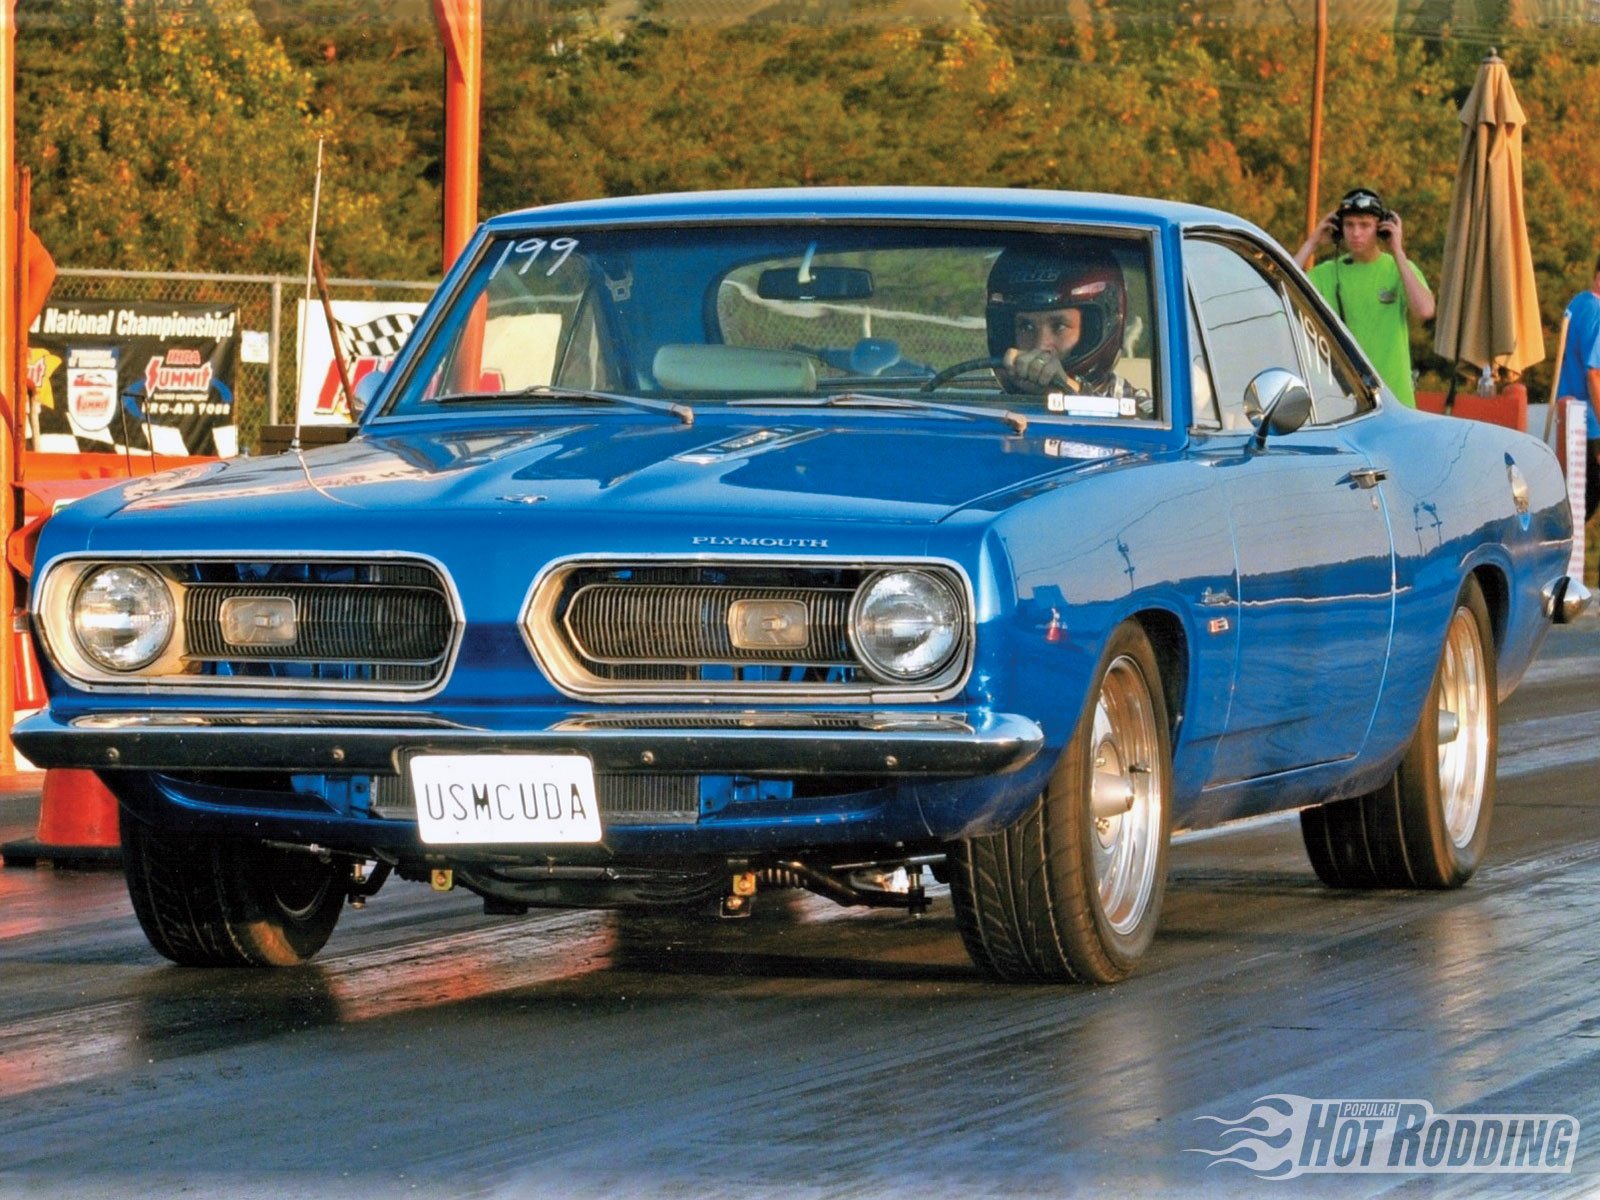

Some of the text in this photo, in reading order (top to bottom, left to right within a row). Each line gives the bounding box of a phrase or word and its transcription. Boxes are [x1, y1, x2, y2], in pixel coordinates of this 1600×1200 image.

[488, 237, 580, 280] 199
[43, 308, 115, 335] National
[116, 309, 235, 343] Championship!
[1298, 309, 1333, 386] 199
[199, 403, 231, 415] TOUR
[691, 536, 829, 548] PLYMOUTH
[425, 783, 587, 821] USMCUDA
